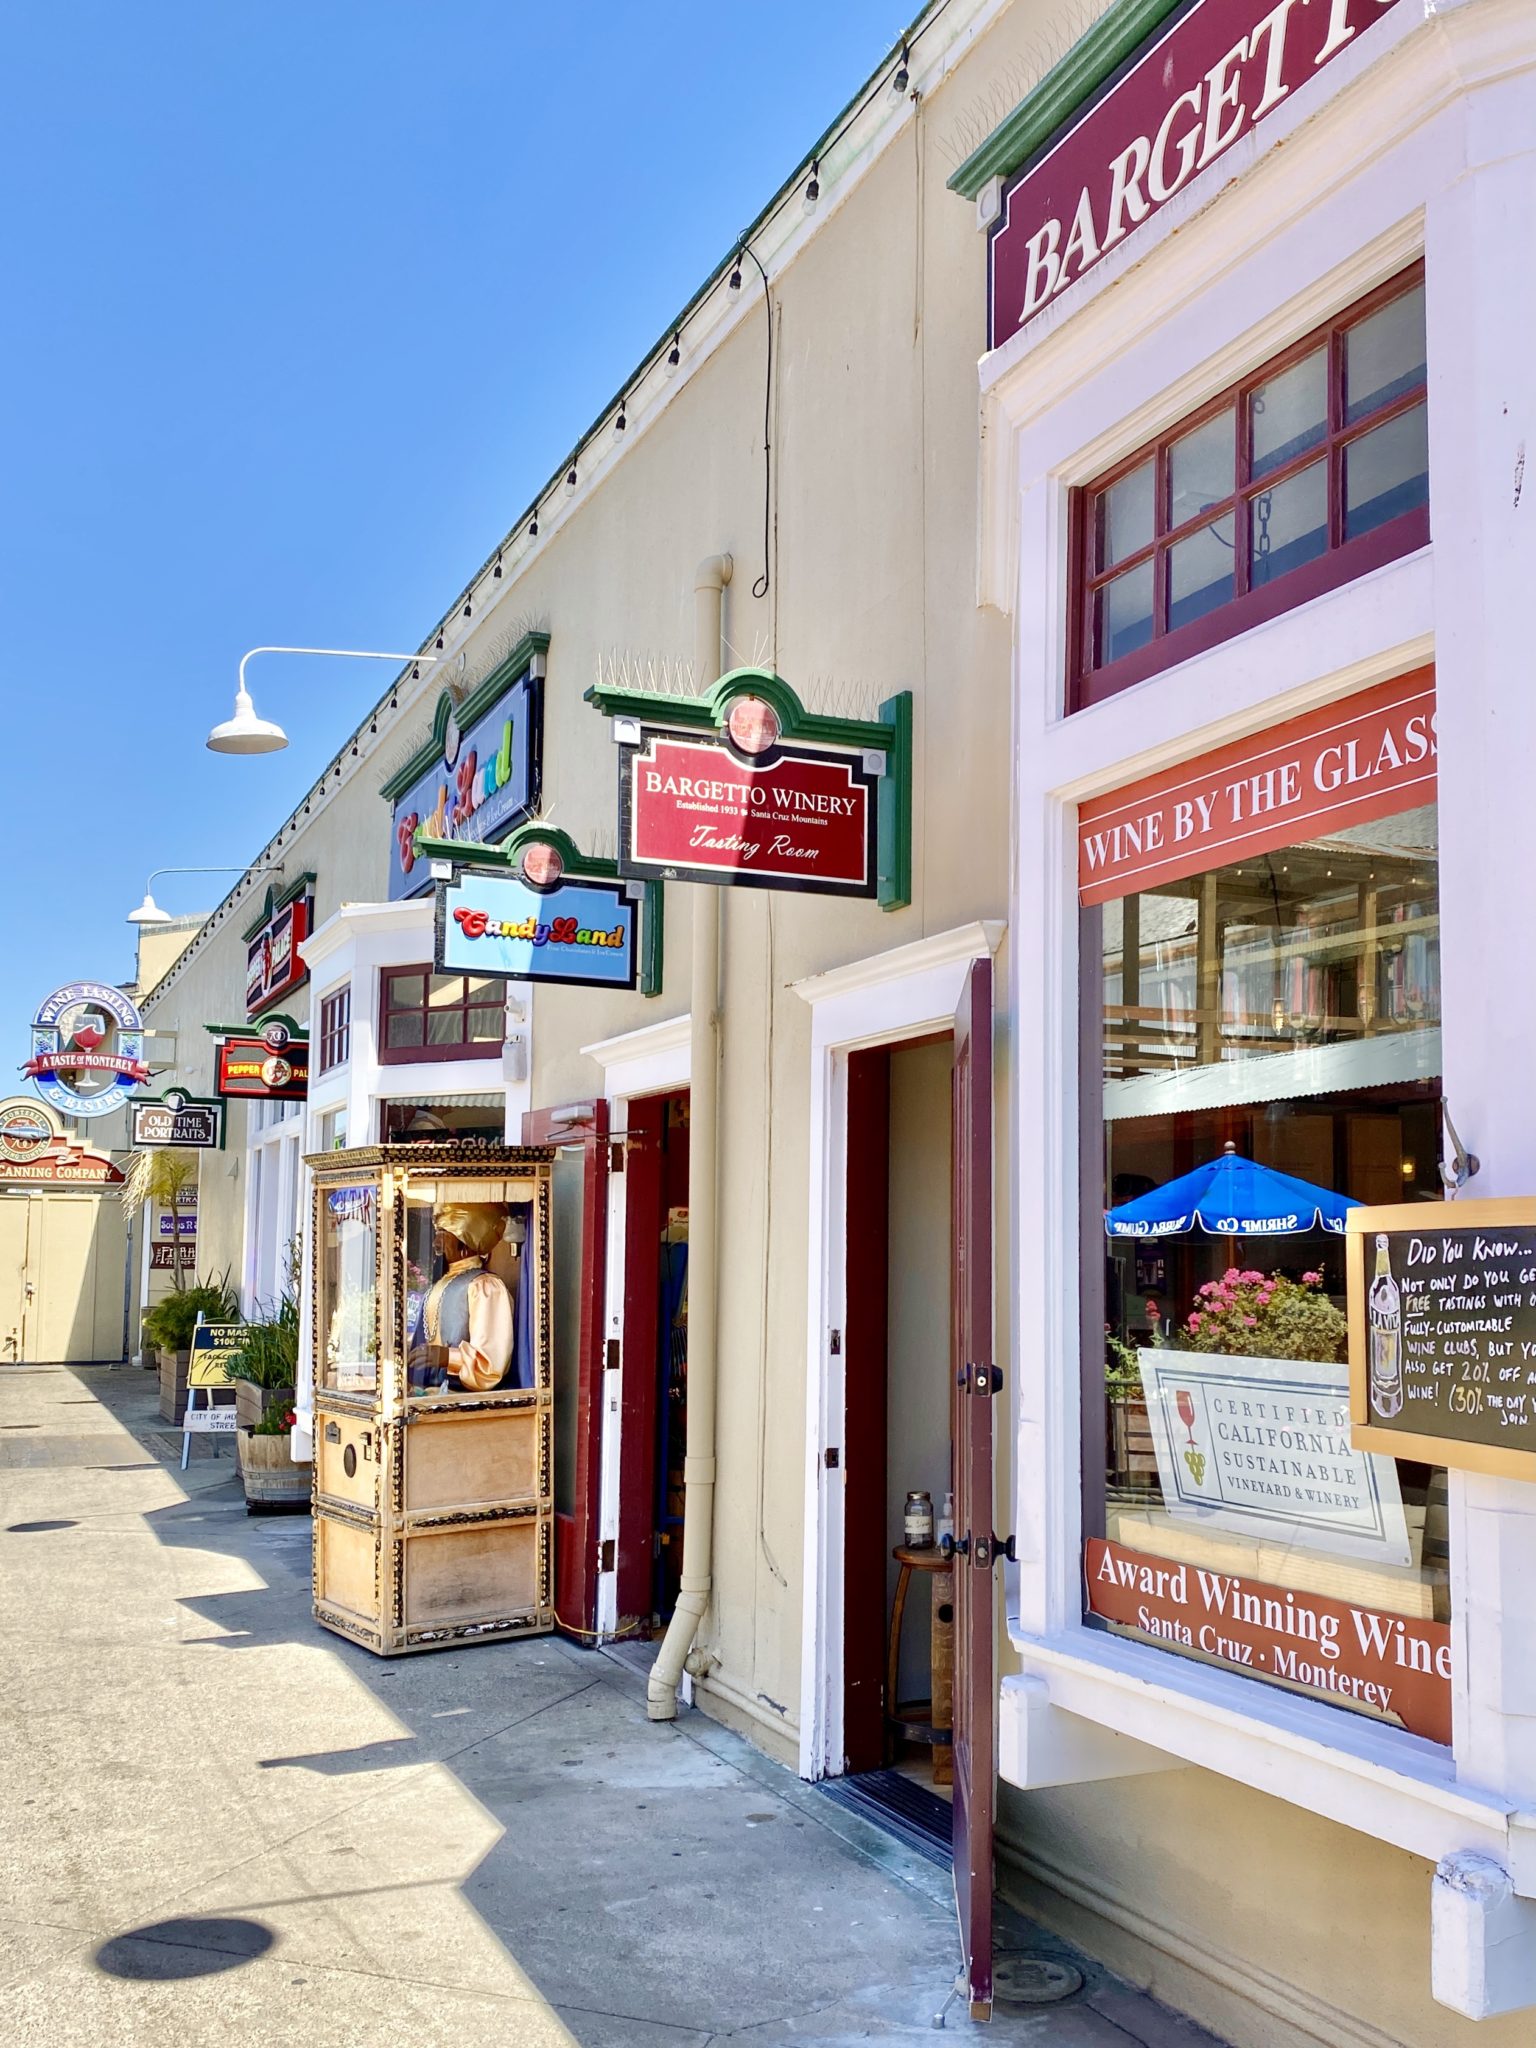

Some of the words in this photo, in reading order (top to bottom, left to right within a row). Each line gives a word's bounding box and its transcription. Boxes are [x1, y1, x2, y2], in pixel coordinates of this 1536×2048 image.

[1019, 0, 1396, 323] BARGETT
[646, 772, 766, 805] BARGETTO
[772, 787, 857, 817] WINERY
[676, 800, 719, 814] Established
[720, 805, 739, 815] 1933
[751, 810, 771, 820] Santa
[772, 812, 790, 821] Cruz
[791, 814, 829, 826] Mountains
[1084, 811, 1164, 871] WINE
[1173, 791, 1217, 842] BY
[1226, 761, 1302, 823] THE
[689, 824, 760, 860] Tasting
[768, 834, 820, 859] Room
[40, 988, 76, 1022] WINE
[82, 983, 135, 1026] TASTING
[42, 1057, 49, 1068] A
[50, 1055, 76, 1066] TASTE
[85, 1055, 134, 1071] MONTEREY
[227, 1065, 260, 1075] PEPPER
[63, 1088, 125, 1113] BISTRO
[143, 1126, 206, 1140] PORTRAITS
[148, 1115, 172, 1127] OLD
[175, 1117, 202, 1128] TIME
[0, 1164, 53, 1179] CANNING
[56, 1166, 114, 1180] COMPANY
[1401, 1277, 1425, 1294] NOT
[1431, 1274, 1457, 1293] ONLY
[1463, 1275, 1479, 1291] DO
[1484, 1270, 1509, 1288] YOU
[1406, 1295, 1431, 1313] FREE
[1439, 1295, 1486, 1312] TASTINGS
[1494, 1293, 1522, 1308] WITH
[1404, 1316, 1513, 1337] FULLY-CUSTOMIZABLE
[1407, 1341, 1436, 1356] WINE
[1443, 1339, 1480, 1360] CLUBS,
[1488, 1342, 1514, 1358] BUT
[1405, 1361, 1426, 1376] ALSO
[1432, 1363, 1454, 1377] GET
[1461, 1362, 1491, 1384] 20%
[1499, 1367, 1521, 1382] OFF
[1407, 1381, 1439, 1407] WINE!
[1487, 1394, 1504, 1408] THE
[1506, 1394, 1526, 1412] DAY
[1213, 1399, 1346, 1427] CERTIFIED
[1218, 1423, 1352, 1457] CALIFORNIA
[1223, 1451, 1356, 1485] SUSTAINABLE
[1228, 1476, 1291, 1499] VINEYARD
[1295, 1487, 1303, 1499] &
[1305, 1489, 1359, 1509] WINERY
[1097, 1547, 1188, 1605] Award
[1196, 1570, 1340, 1659] Winning
[1138, 1606, 1192, 1647] Santa
[1199, 1625, 1253, 1666] Cruz
[1272, 1646, 1393, 1712] Monterey
